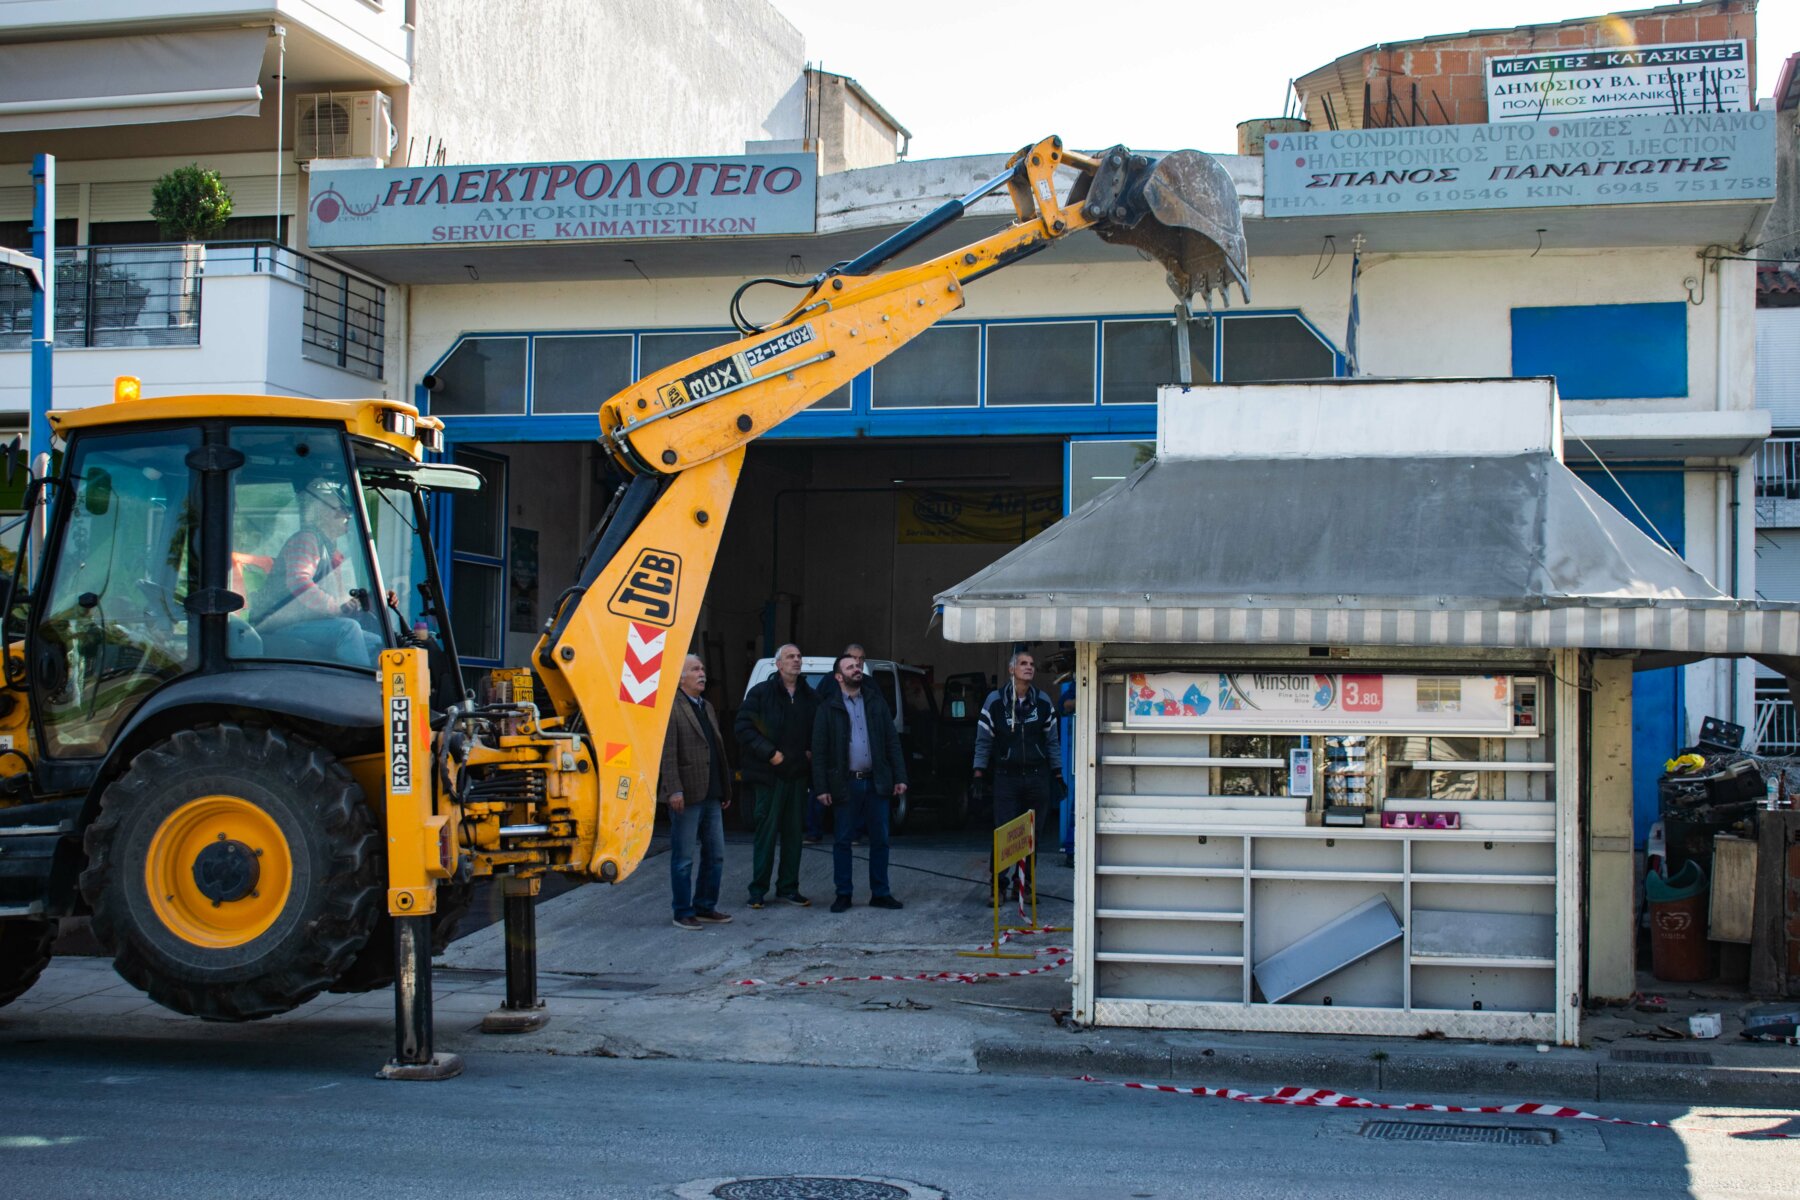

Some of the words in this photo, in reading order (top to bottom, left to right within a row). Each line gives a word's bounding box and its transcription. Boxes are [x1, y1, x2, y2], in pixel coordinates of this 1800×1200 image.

[1496, 56, 1587, 74] ΜΕΛΕΤΕΣ
[1607, 46, 1739, 65] ΚΑΤΑΣΚΕΥΕΣ
[1494, 77, 1604, 96] ΔΗΜΟΣΙΟΥ
[1610, 75, 1641, 87] ΒΛ.
[1502, 96, 1587, 109] ΠΟΛΙΤΙΚΟΣ
[1592, 89, 1687, 103] ΜΗΧΑΝΙΚΟΣ
[1280, 135, 1319, 151] AIR
[1330, 128, 1460, 149] CONDITION
[1472, 124, 1535, 143] AUTO
[1562, 120, 1632, 138] ΜΙΖΕΣ
[1663, 114, 1767, 134] ΔΥΝΑΜΟ
[1308, 146, 1489, 169] ΗΛΕΚΤΡΟΝΙΚΟΣ
[1505, 140, 1615, 160] ΕΛΕΝΧΟΣ
[1628, 136, 1737, 155] IJECTION
[382, 162, 802, 207] ΗΛΕΚΤΡΟΛΟΓΕΙΟ
[1305, 167, 1460, 188] ΣΠΑΝΟΣ
[1488, 156, 1731, 180] ΠΑΝΑΓΙΩΤΗΣ
[1341, 192, 1401, 205] 2410
[1416, 188, 1508, 202] 610546
[1526, 185, 1581, 197] ΚΙΝ.
[1596, 181, 1660, 195] 6945
[1675, 177, 1772, 192] 751758
[475, 201, 697, 221] ΑΥΤΟΚΙΝΗΤΩΝ
[432, 223, 536, 241] SERVICE
[555, 217, 756, 237] ΚΛΙΜΑΤΙΣΤΙΚΩΝ
[746, 327, 810, 365] UNITRACK
[689, 362, 738, 399] 3CX
[618, 554, 675, 620] JCB
[1252, 674, 1309, 690] Winston
[392, 699, 409, 786] UNITRACK
